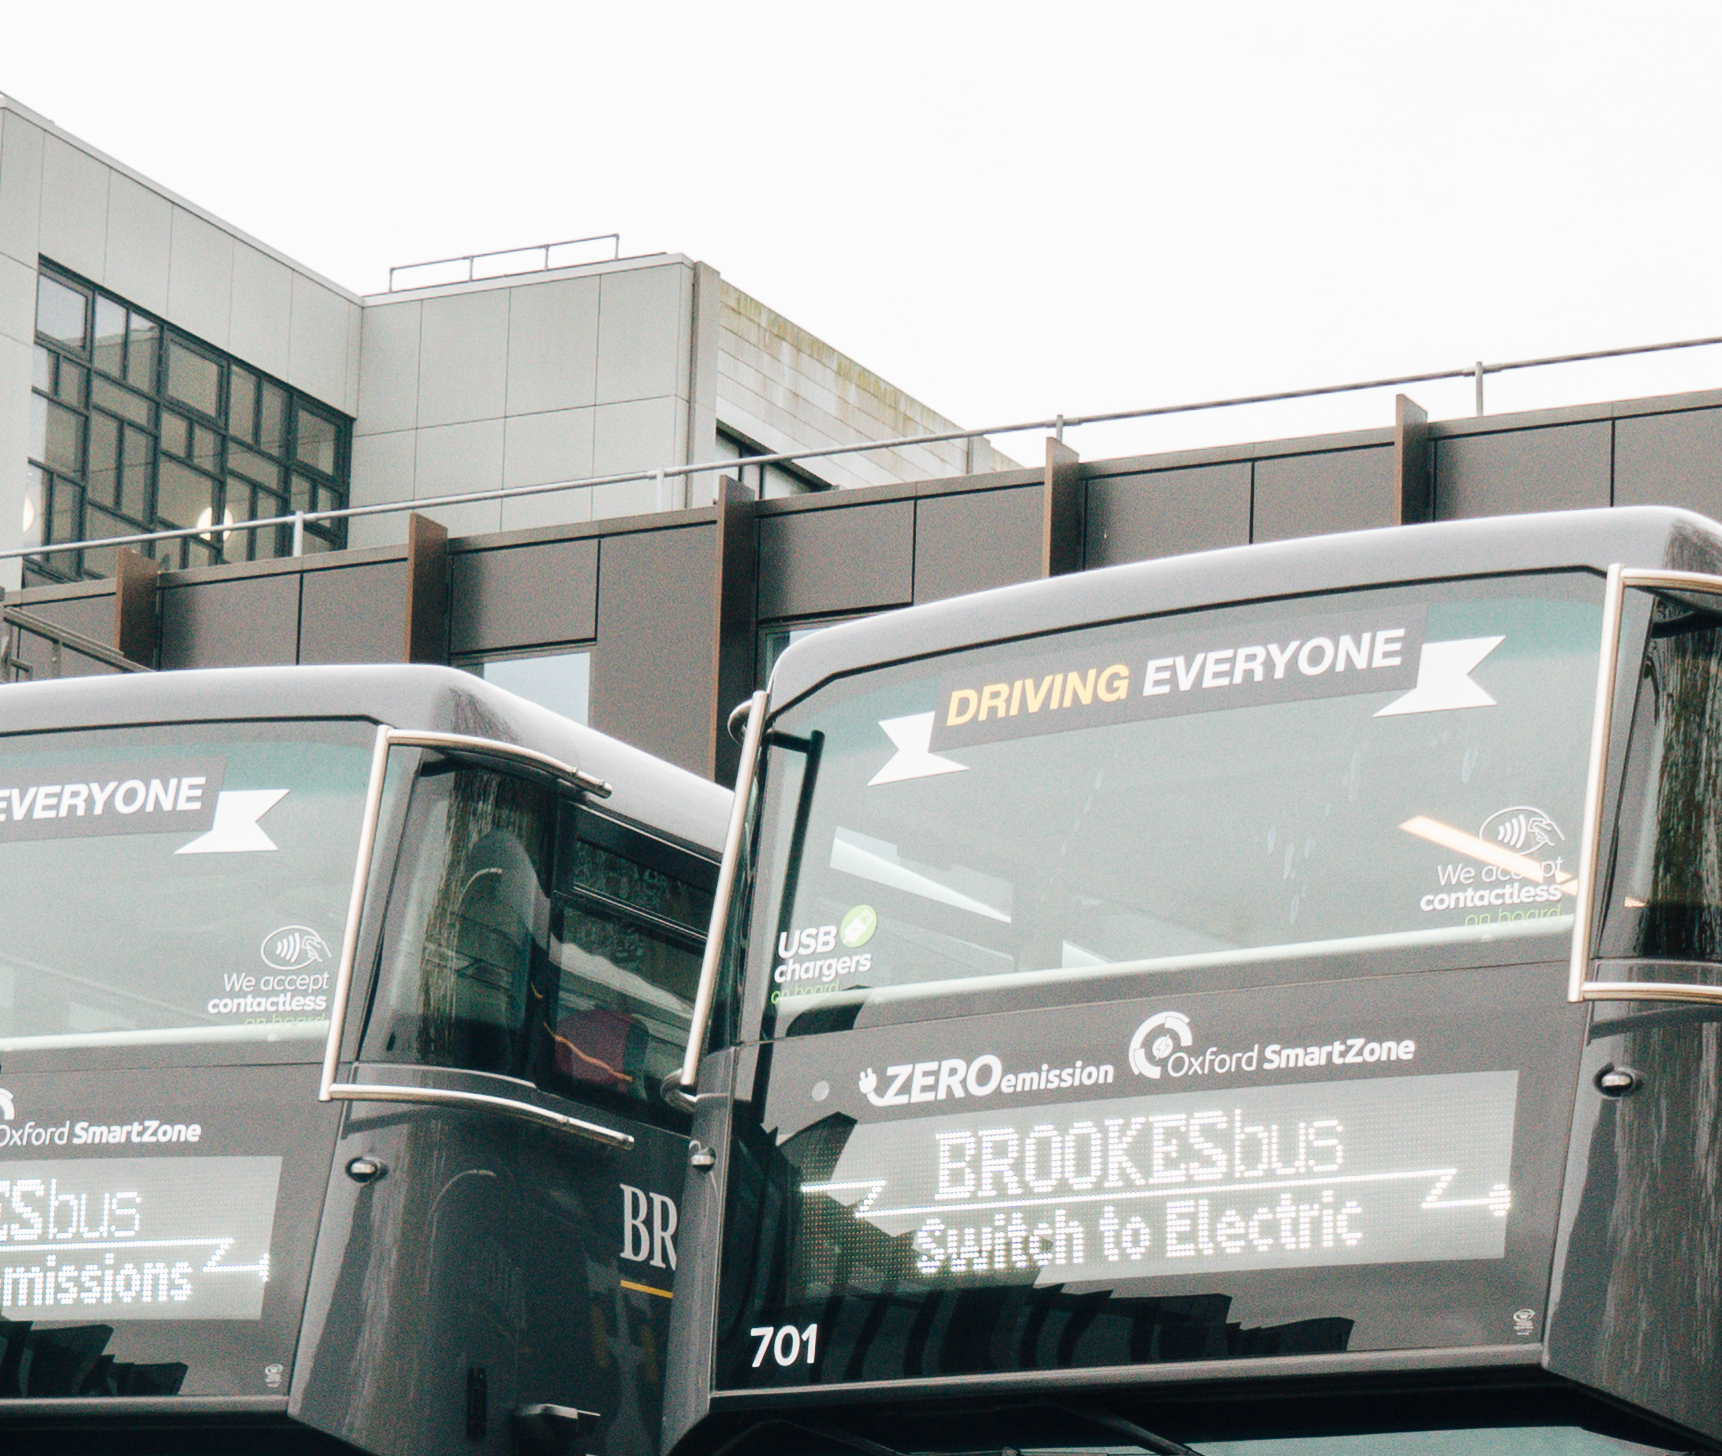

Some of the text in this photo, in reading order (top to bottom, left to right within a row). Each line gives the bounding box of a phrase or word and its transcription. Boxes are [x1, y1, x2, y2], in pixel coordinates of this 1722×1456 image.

[946, 628, 1405, 727] DRIVING EVERYONE
[1437, 856, 1563, 886] We accpt
[1420, 882, 1562, 911] contactless
[1465, 912, 1491, 928] on
[778, 925, 837, 959] USB
[224, 971, 330, 993] We accept
[774, 953, 872, 983] chargers
[207, 992, 328, 1014] contactless
[1167, 1043, 1256, 1077] Oxford
[1262, 1037, 1415, 1070] SmartZone
[72, 1120, 202, 1145] SmartZone
[935, 1109, 1343, 1200] BROOKESbus
[917, 1190, 1362, 1274] Switch to Electric
[750, 1324, 817, 1367] 701
